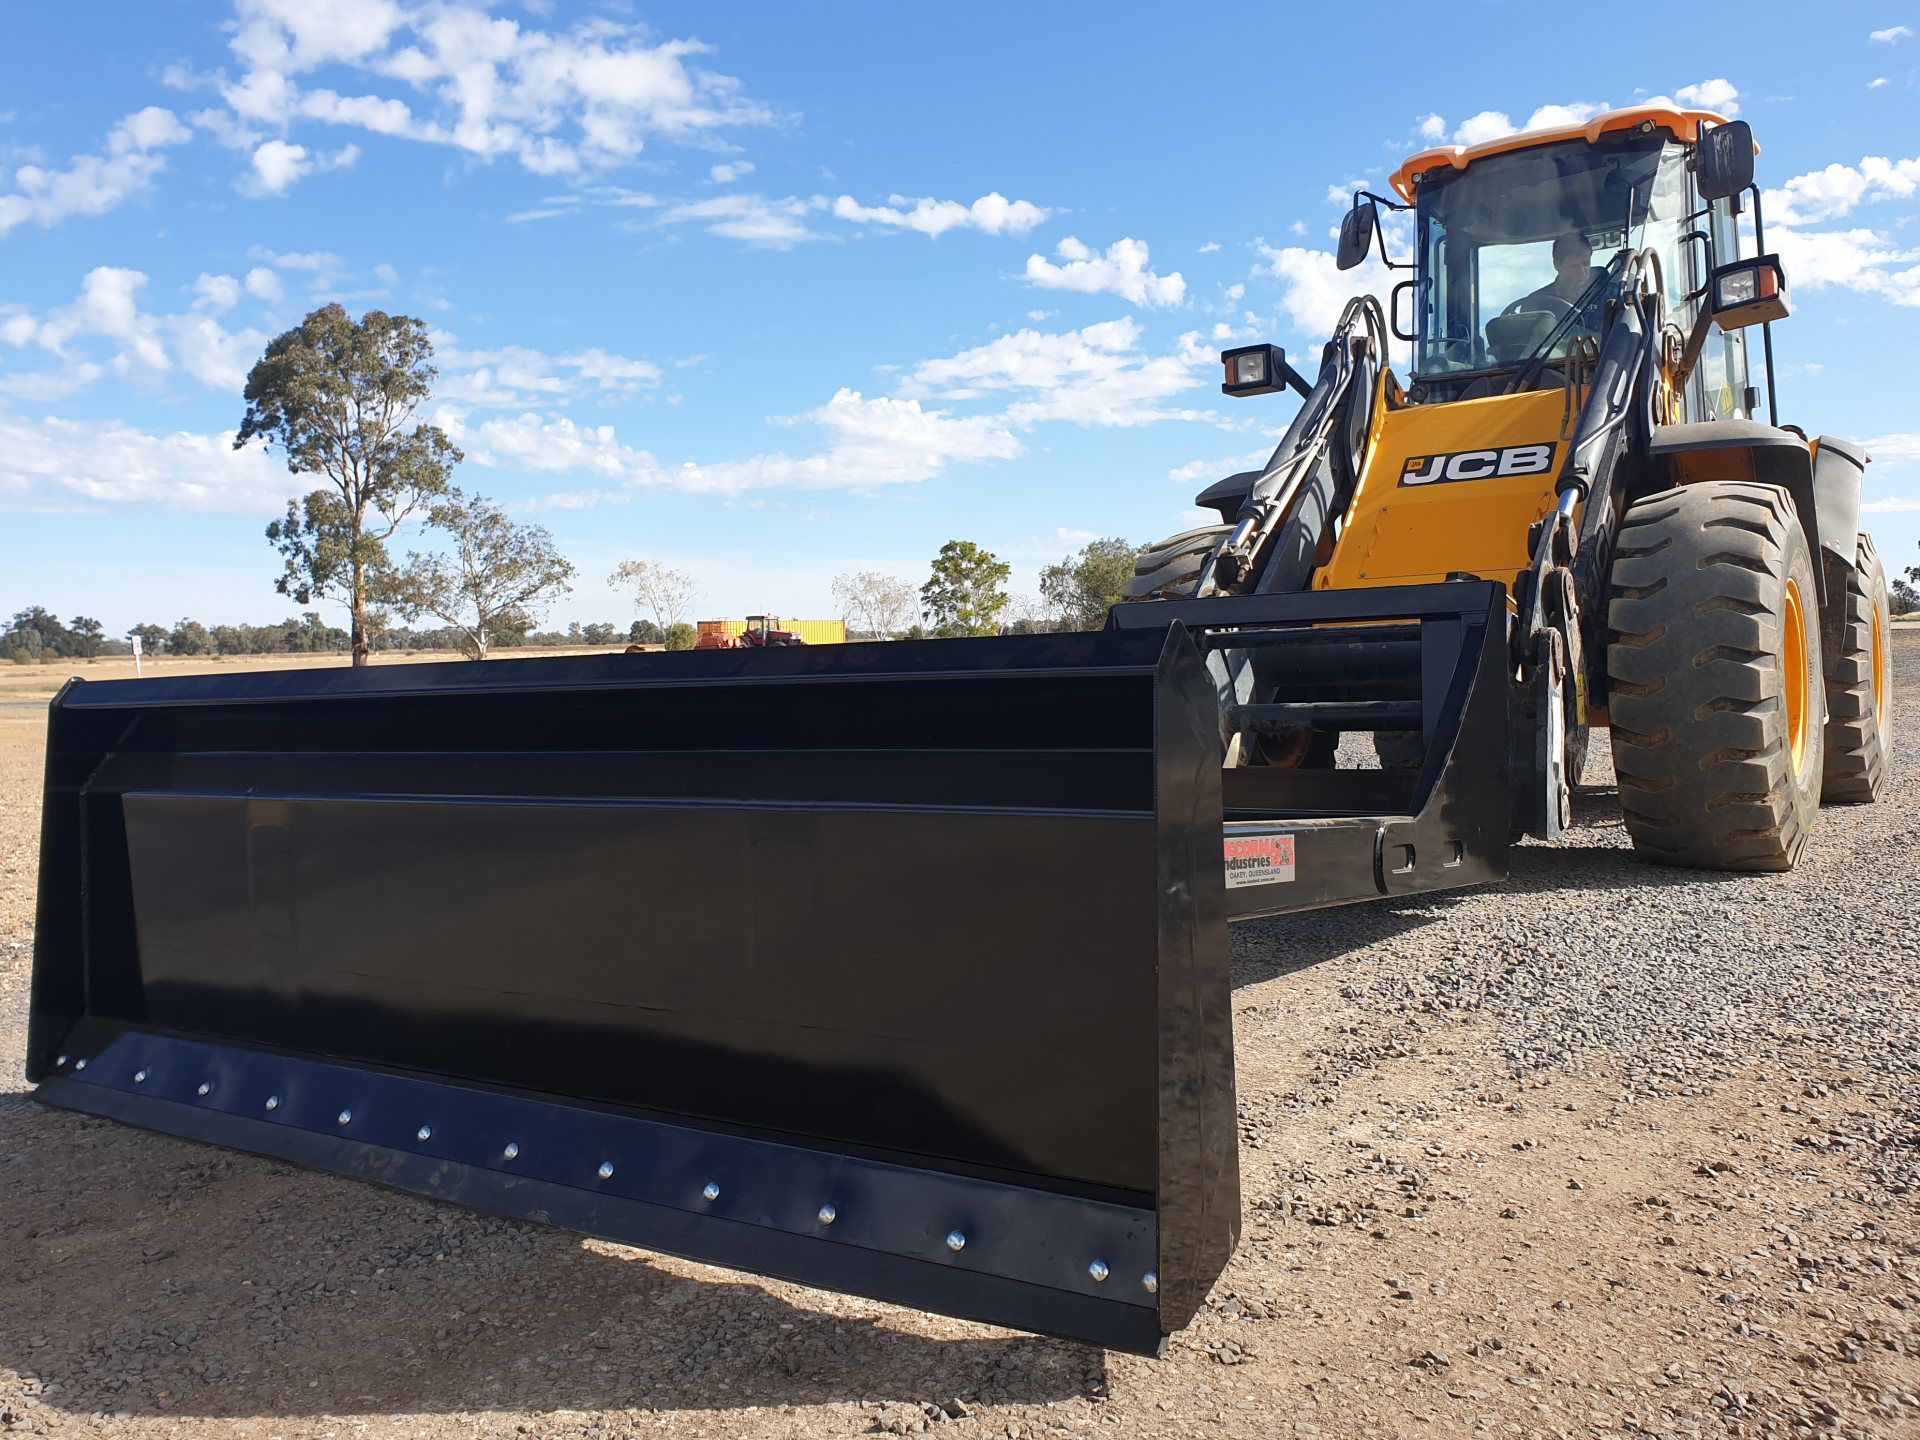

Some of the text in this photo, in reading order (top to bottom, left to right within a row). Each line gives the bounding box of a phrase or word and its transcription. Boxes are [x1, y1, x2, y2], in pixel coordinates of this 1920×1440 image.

[1403, 445, 1550, 484] JCB
[1224, 856, 1270, 871] ndustries
[1230, 868, 1280, 880] OAKEY, QUEENSLAND
